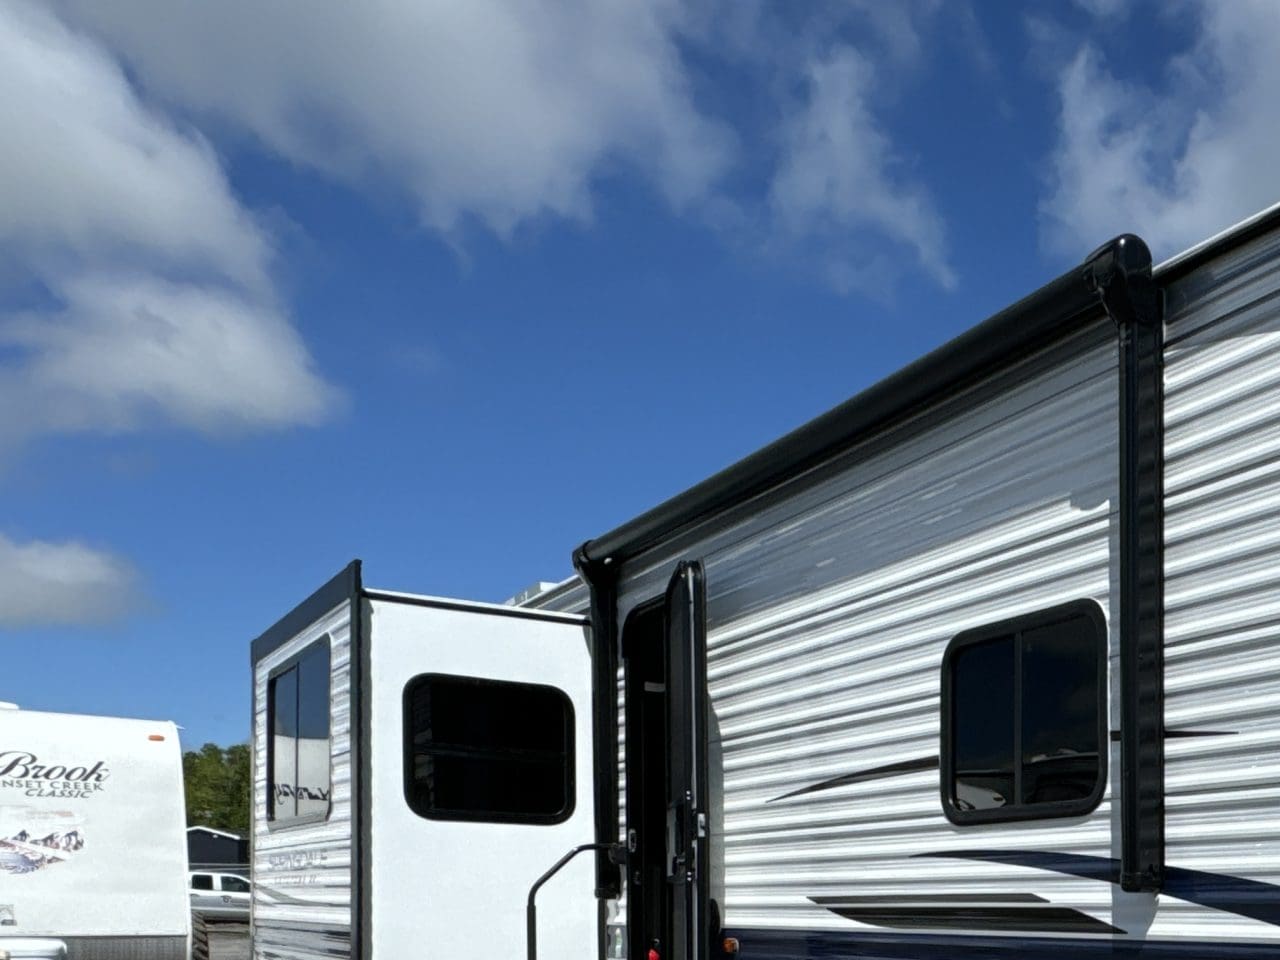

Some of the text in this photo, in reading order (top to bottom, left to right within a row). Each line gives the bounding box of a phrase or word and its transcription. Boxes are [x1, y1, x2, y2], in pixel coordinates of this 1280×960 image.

[0, 751, 110, 781] Brook
[49, 781, 104, 791] CREEK
[25, 789, 93, 798] CLASSIC
